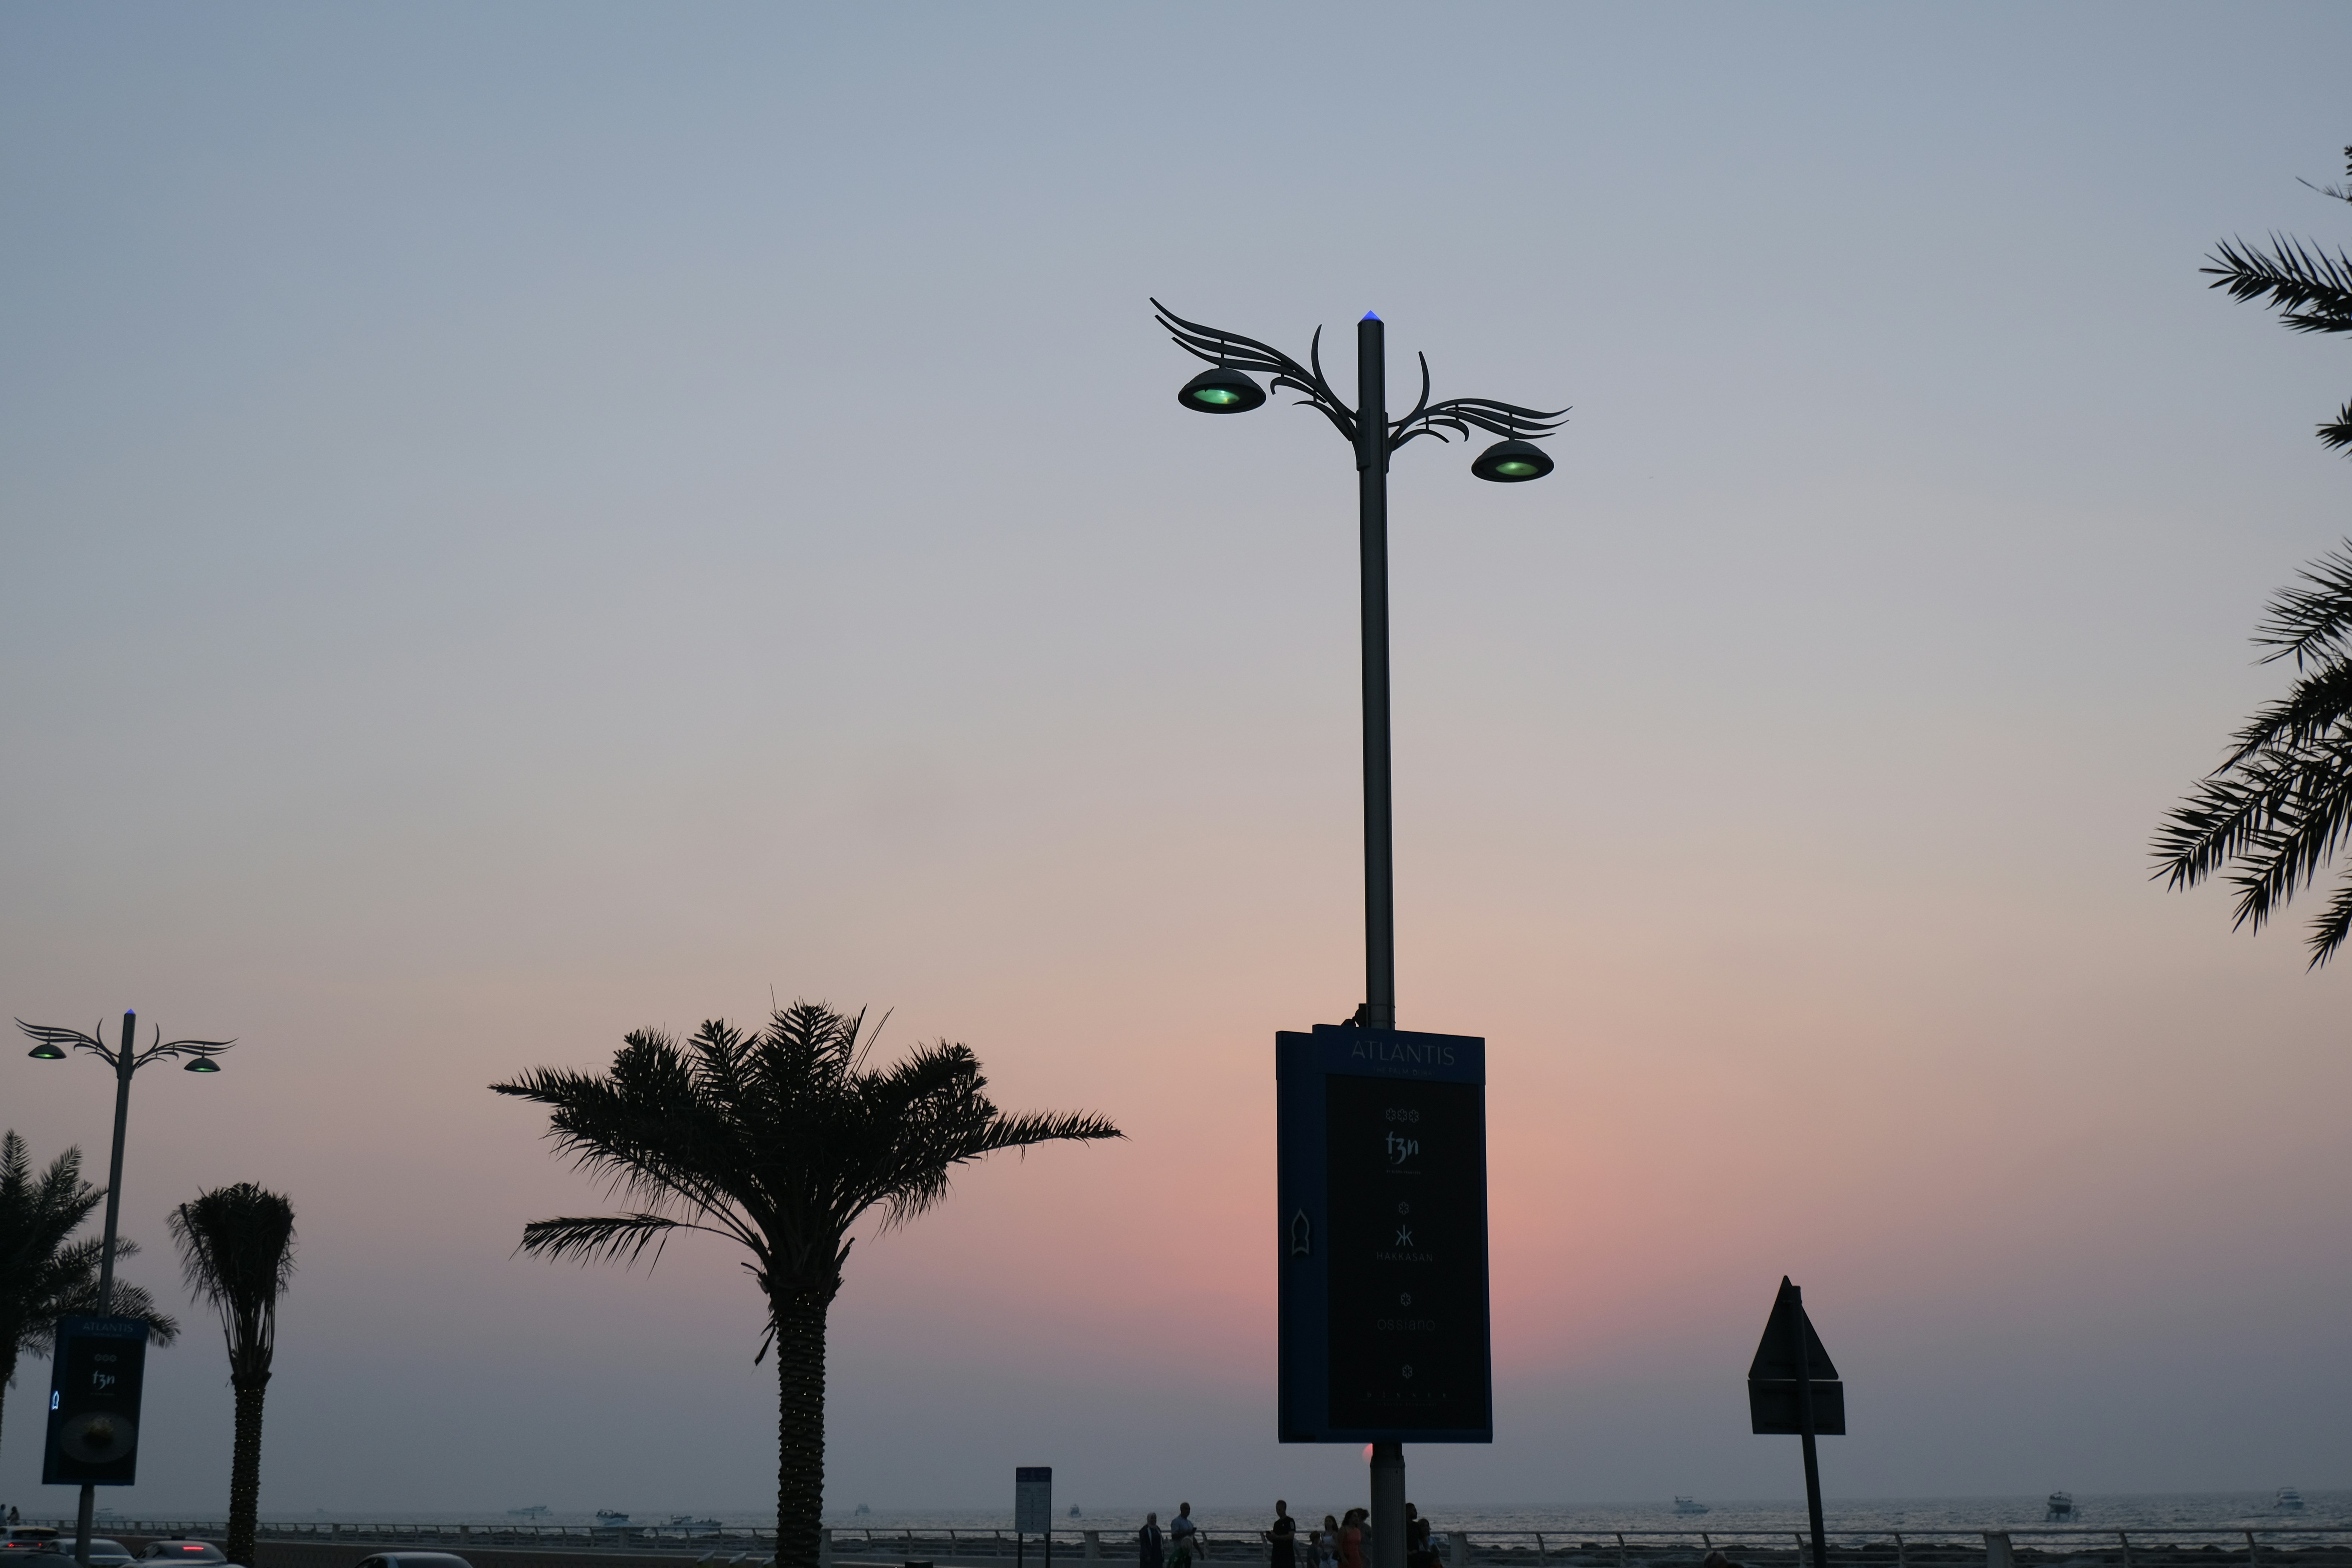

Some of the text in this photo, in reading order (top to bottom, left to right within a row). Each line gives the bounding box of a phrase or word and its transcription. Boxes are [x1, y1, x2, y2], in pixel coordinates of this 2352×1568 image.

[1351, 1040, 1454, 1065] ATLANTIS
[1377, 1251, 1433, 1262] HAKKASAN
[83, 1322, 133, 1332] ATLANTIS
[1377, 1318, 1435, 1331] ossiano
